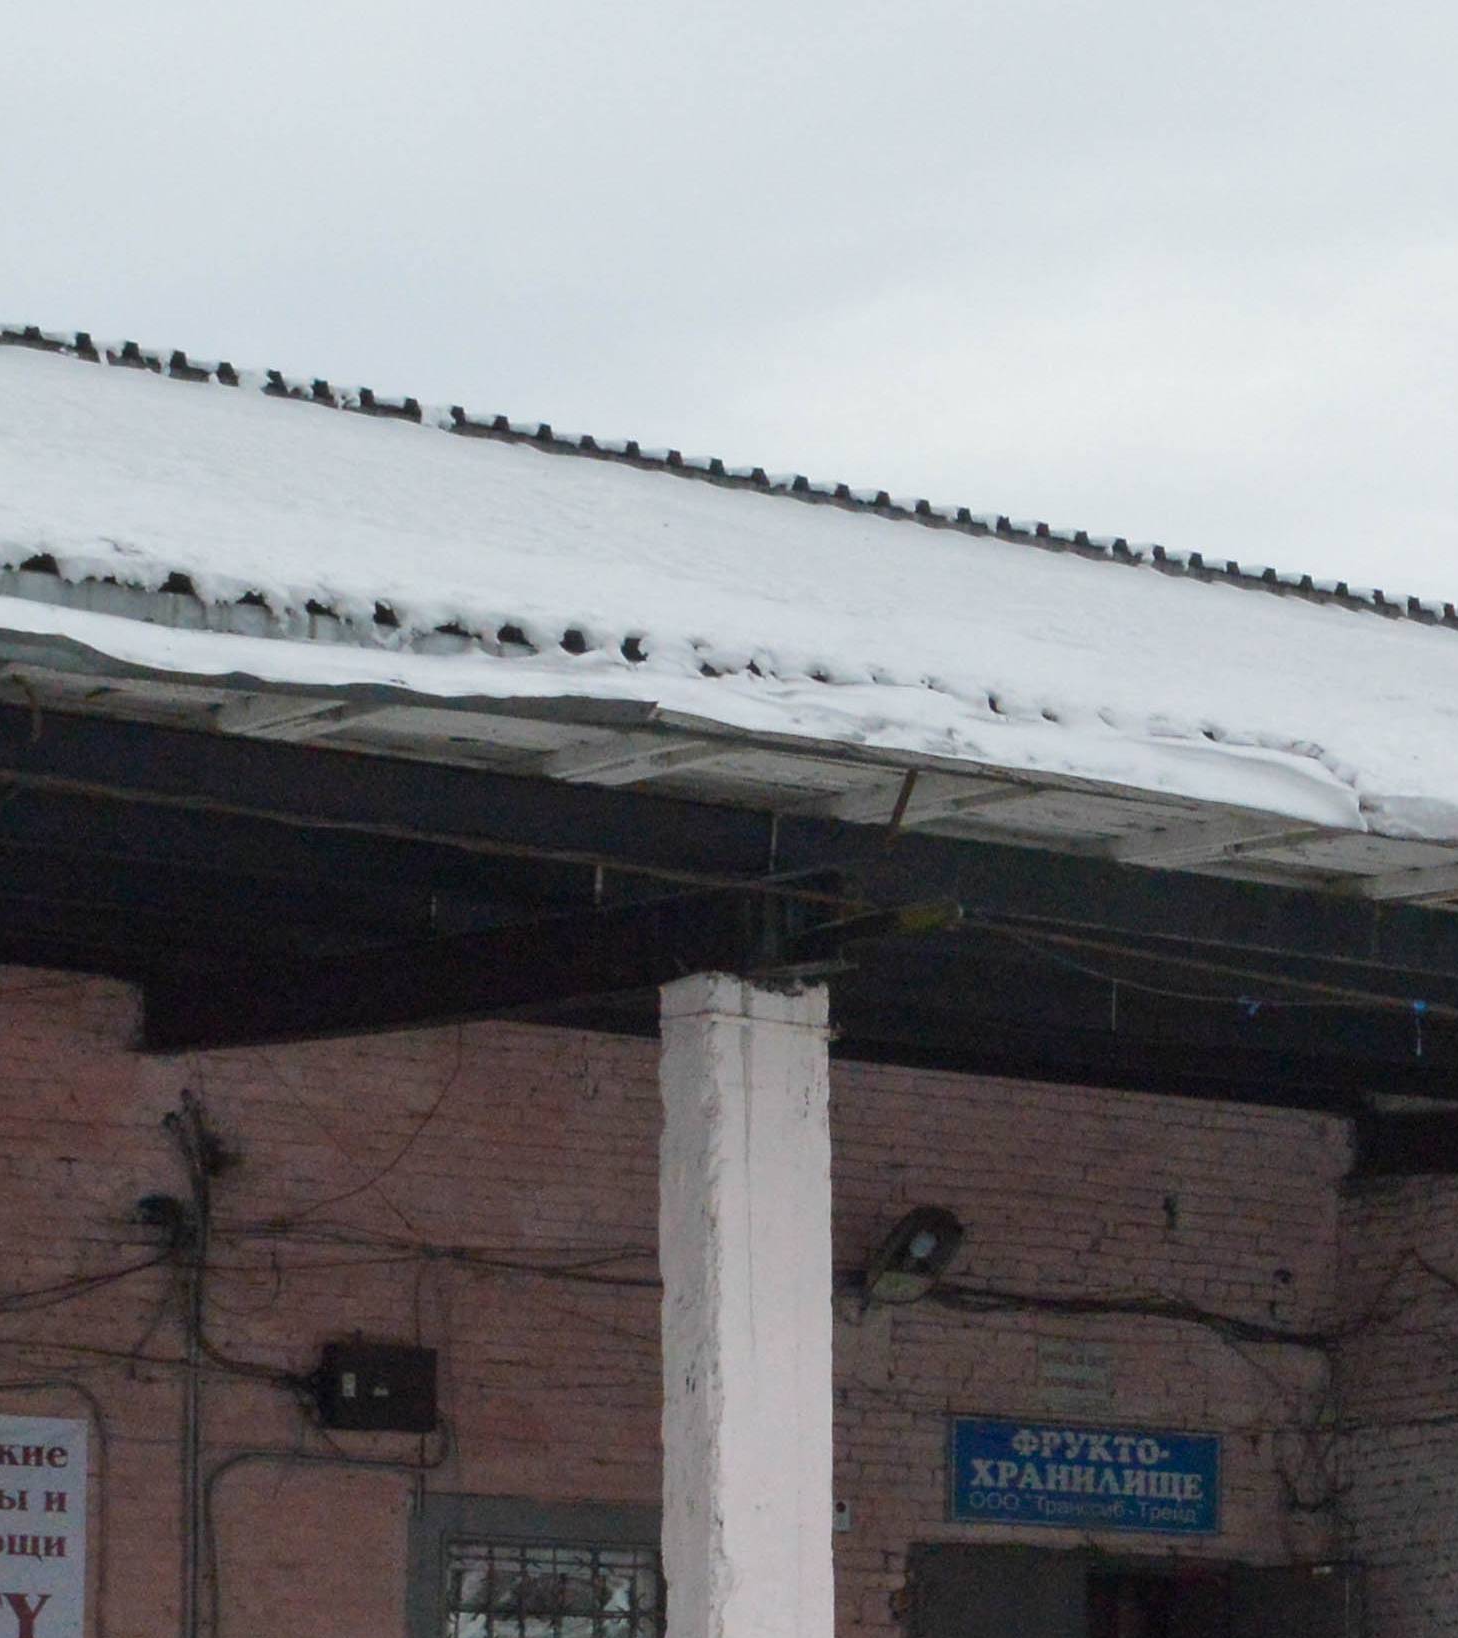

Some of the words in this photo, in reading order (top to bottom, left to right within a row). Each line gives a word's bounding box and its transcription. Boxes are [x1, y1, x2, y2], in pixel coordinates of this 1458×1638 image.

[1012, 1429, 1170, 1465] ФРУКТО-
[969, 1459, 1204, 1502] ХРАНИЛИЩЕ
[44, 1490, 67, 1512] и
[969, 1491, 1020, 1511] ООО
